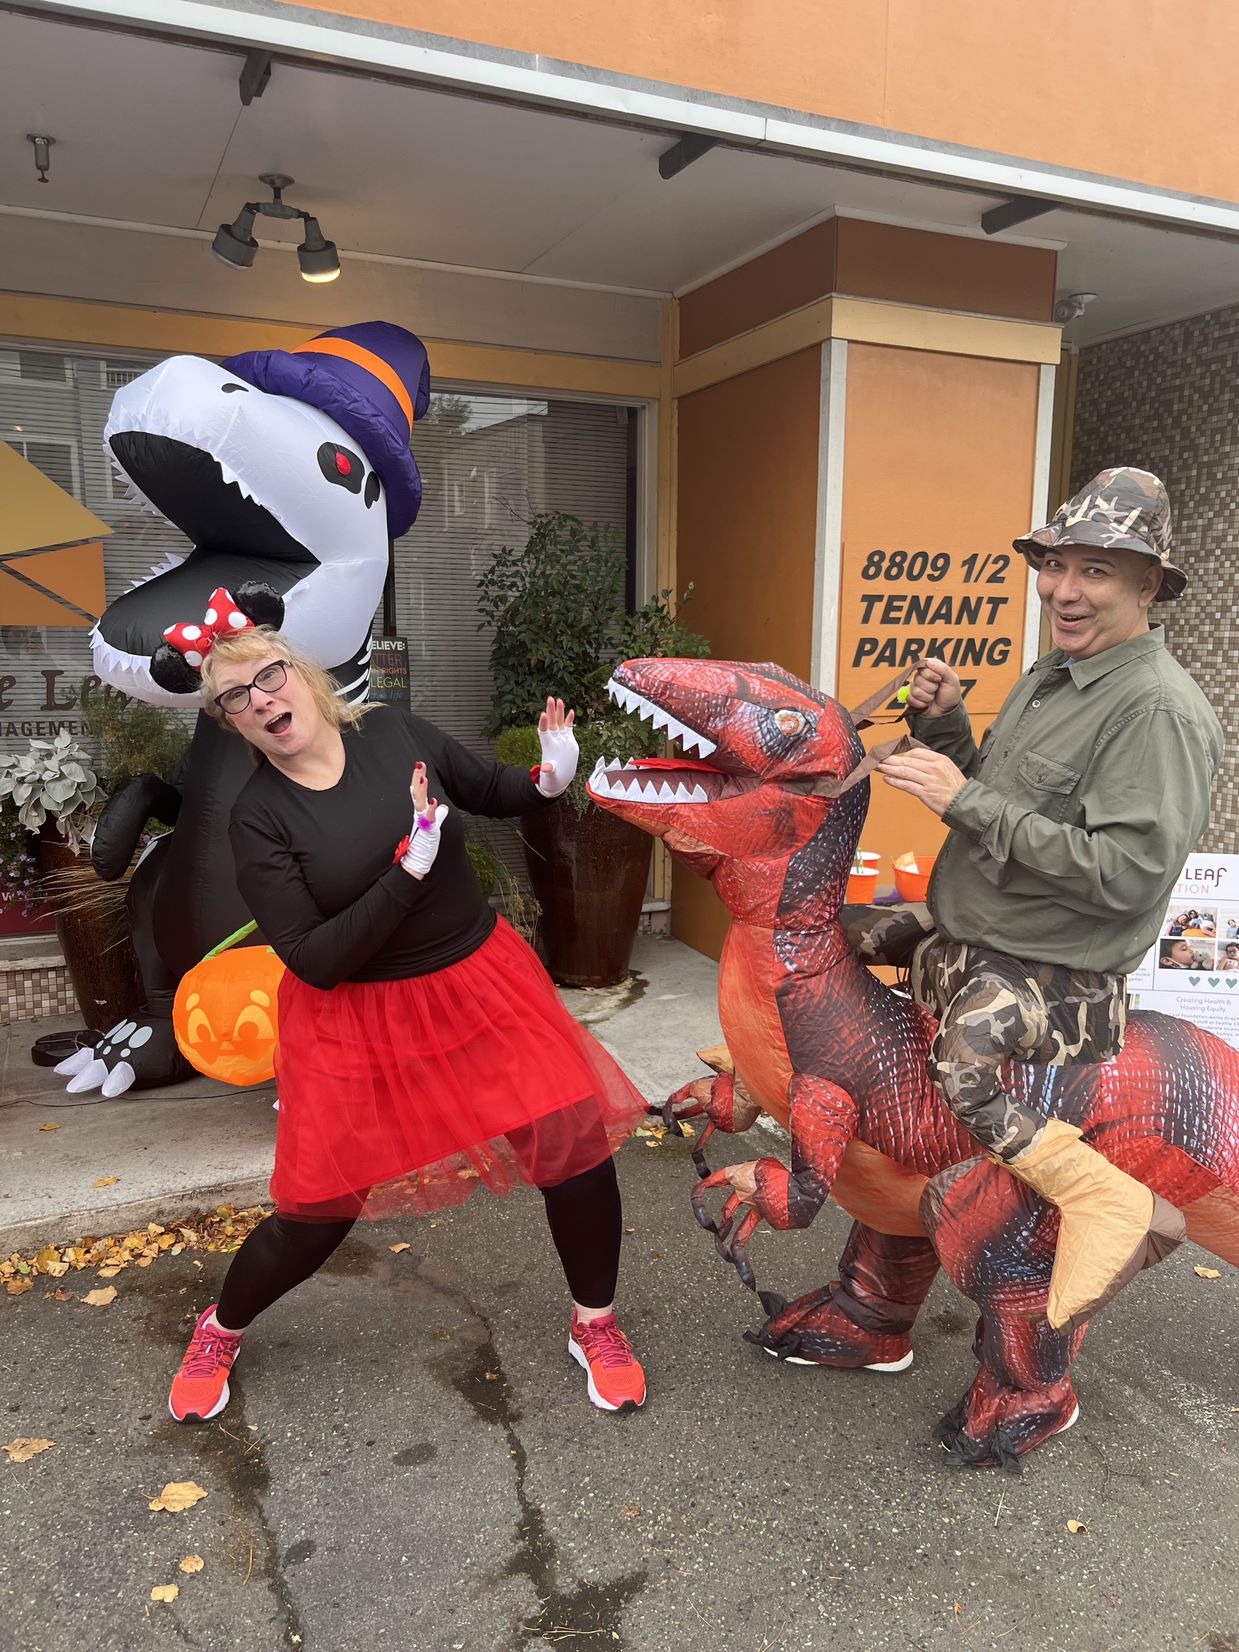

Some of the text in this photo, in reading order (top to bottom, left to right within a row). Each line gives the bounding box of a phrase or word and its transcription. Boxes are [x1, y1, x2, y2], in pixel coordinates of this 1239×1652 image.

[861, 549, 1011, 584] 8809 1/2
[860, 593, 1009, 626] TENANT
[371, 640, 406, 651] ELIEVE:
[371, 652, 402, 666] TTER
[852, 637, 1012, 668] PARKING
[370, 676, 408, 689] LEGAL
[0, 720, 93, 737] AGEMEN
[1173, 883, 1210, 895] TION
[1175, 996, 1203, 1005] Creating
[1180, 1004, 1226, 1014] Housing Equity
